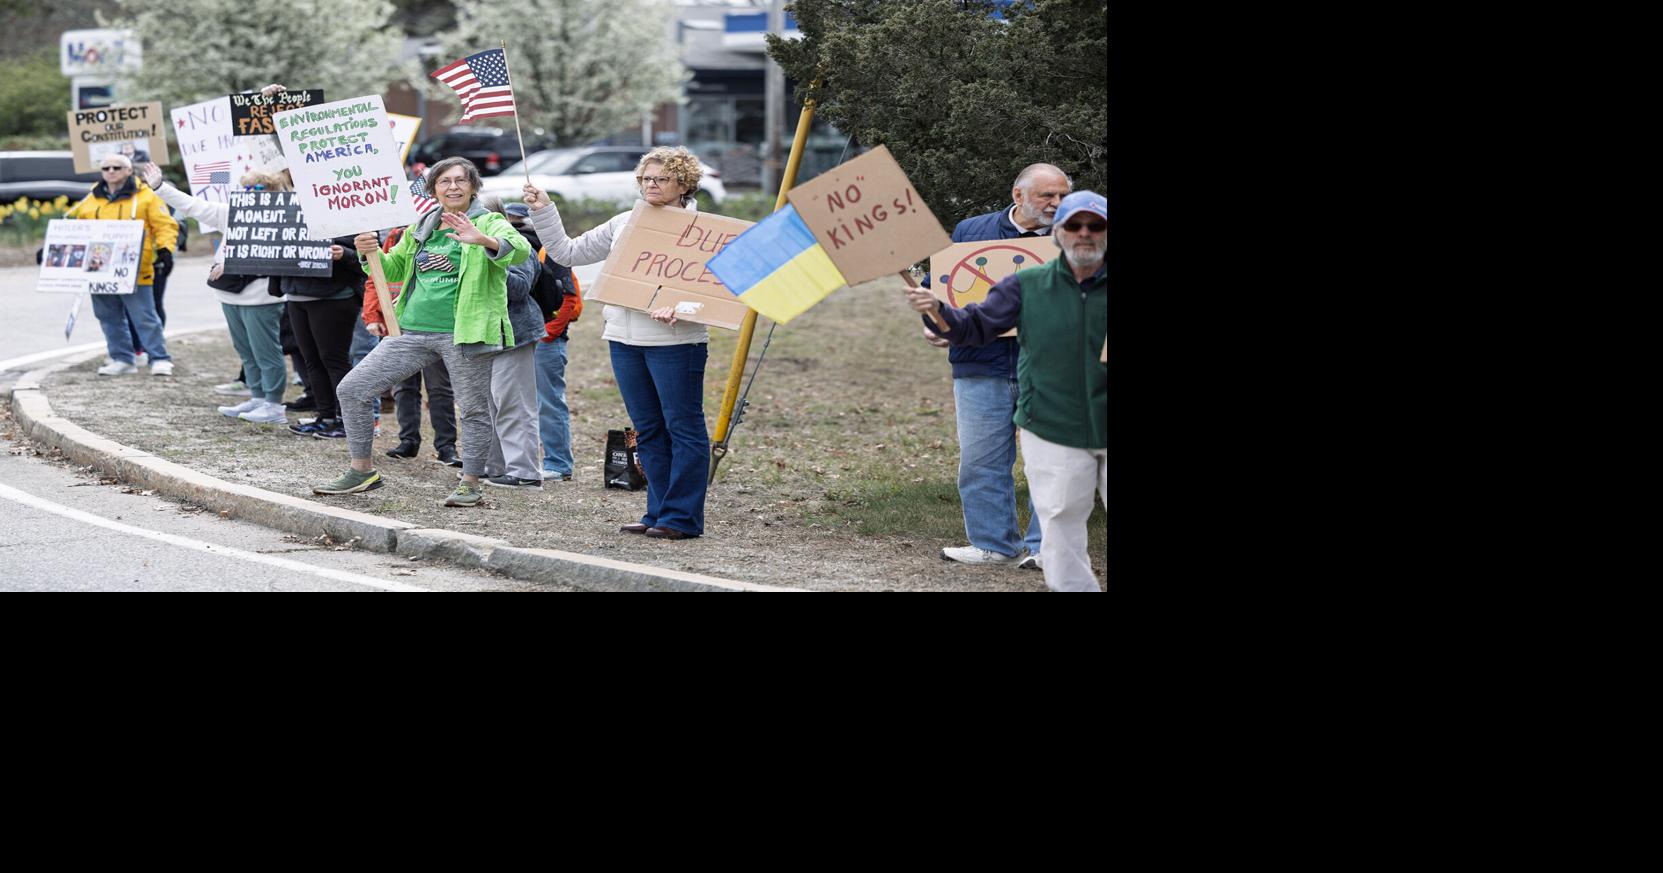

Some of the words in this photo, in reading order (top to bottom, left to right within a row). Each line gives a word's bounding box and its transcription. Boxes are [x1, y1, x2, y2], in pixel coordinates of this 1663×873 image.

[278, 90, 311, 106] People
[76, 106, 148, 125] PROTECT
[188, 104, 224, 130] NO
[105, 122, 124, 132] OUR
[298, 132, 368, 154] PROTECT
[332, 165, 363, 181] YOU
[230, 193, 256, 207] THIS
[260, 193, 271, 206] IS
[275, 193, 285, 206] A
[328, 184, 399, 210] MORON!
[233, 210, 287, 223] MOMENT.
[227, 226, 249, 240] NOT
[251, 227, 279, 241] LEFT
[282, 227, 297, 240] OR
[225, 245, 235, 258] IT
[237, 244, 249, 259] IS
[250, 244, 281, 259] RIGHT
[283, 245, 297, 258] OR
[114, 267, 129, 278] NO
[631, 251, 724, 286] PROCE
[88, 281, 119, 293] KINGS
